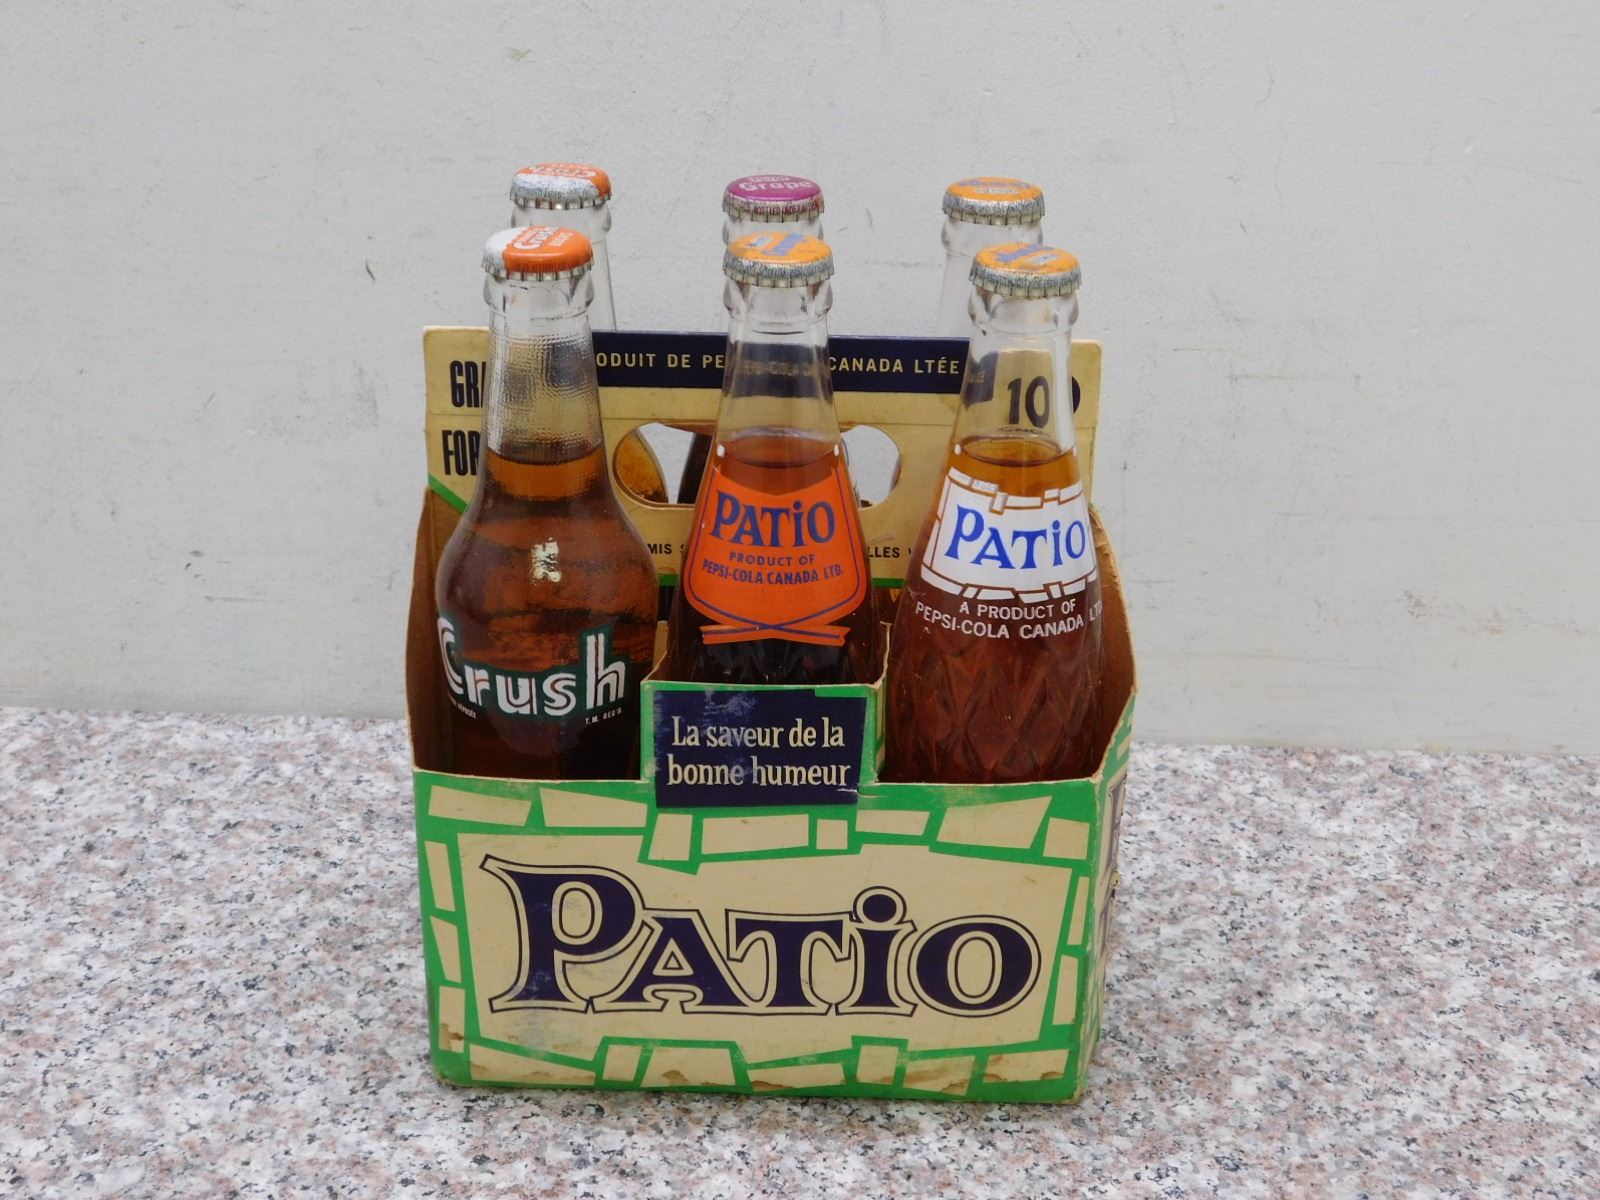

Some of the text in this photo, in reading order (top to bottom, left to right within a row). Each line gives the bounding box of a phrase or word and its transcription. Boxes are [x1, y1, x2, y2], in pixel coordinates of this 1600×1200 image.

[667, 353, 691, 368] DE
[828, 356, 903, 373] CANADA
[914, 357, 960, 375] LTÉE
[1008, 375, 1050, 429] 10
[702, 558, 764, 585] PEPSI-COLA
[767, 569, 819, 585] CANADA
[729, 551, 816, 567] PRODUCT OF
[915, 601, 1010, 639] PEPSI-COLA
[1019, 616, 1084, 640] CANADA
[959, 598, 1077, 621] A PRODUCT OF
[437, 616, 626, 717] Crush
[671, 715, 845, 748] La saveur de la
[667, 753, 851, 788] bonne humeur
